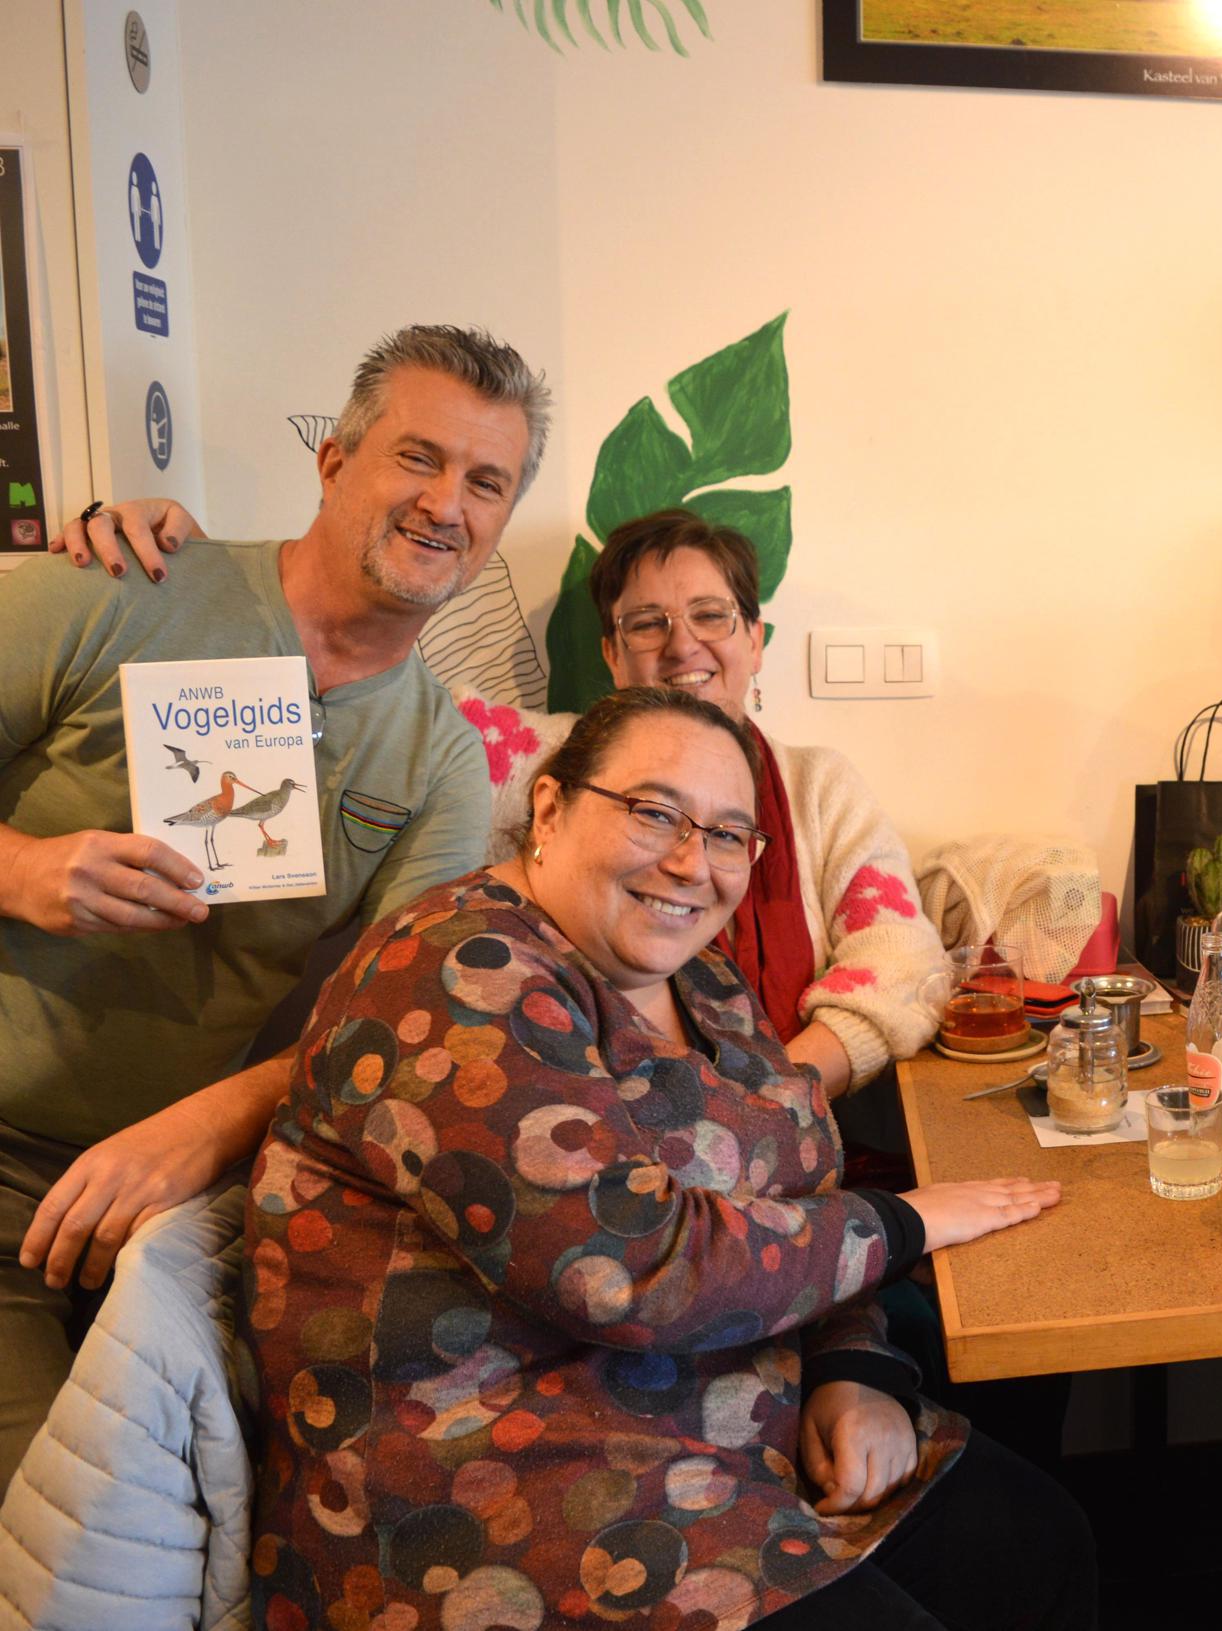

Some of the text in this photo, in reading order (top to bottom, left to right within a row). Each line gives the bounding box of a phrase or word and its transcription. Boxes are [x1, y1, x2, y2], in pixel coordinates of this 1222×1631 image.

[1143, 67, 1193, 83] Kasteel
[1195, 74, 1218, 85] van
[0, 421, 20, 431] alle
[178, 686, 224, 701] ANWB
[152, 696, 301, 736] Vogelgids
[225, 735, 304, 750] van Europa
